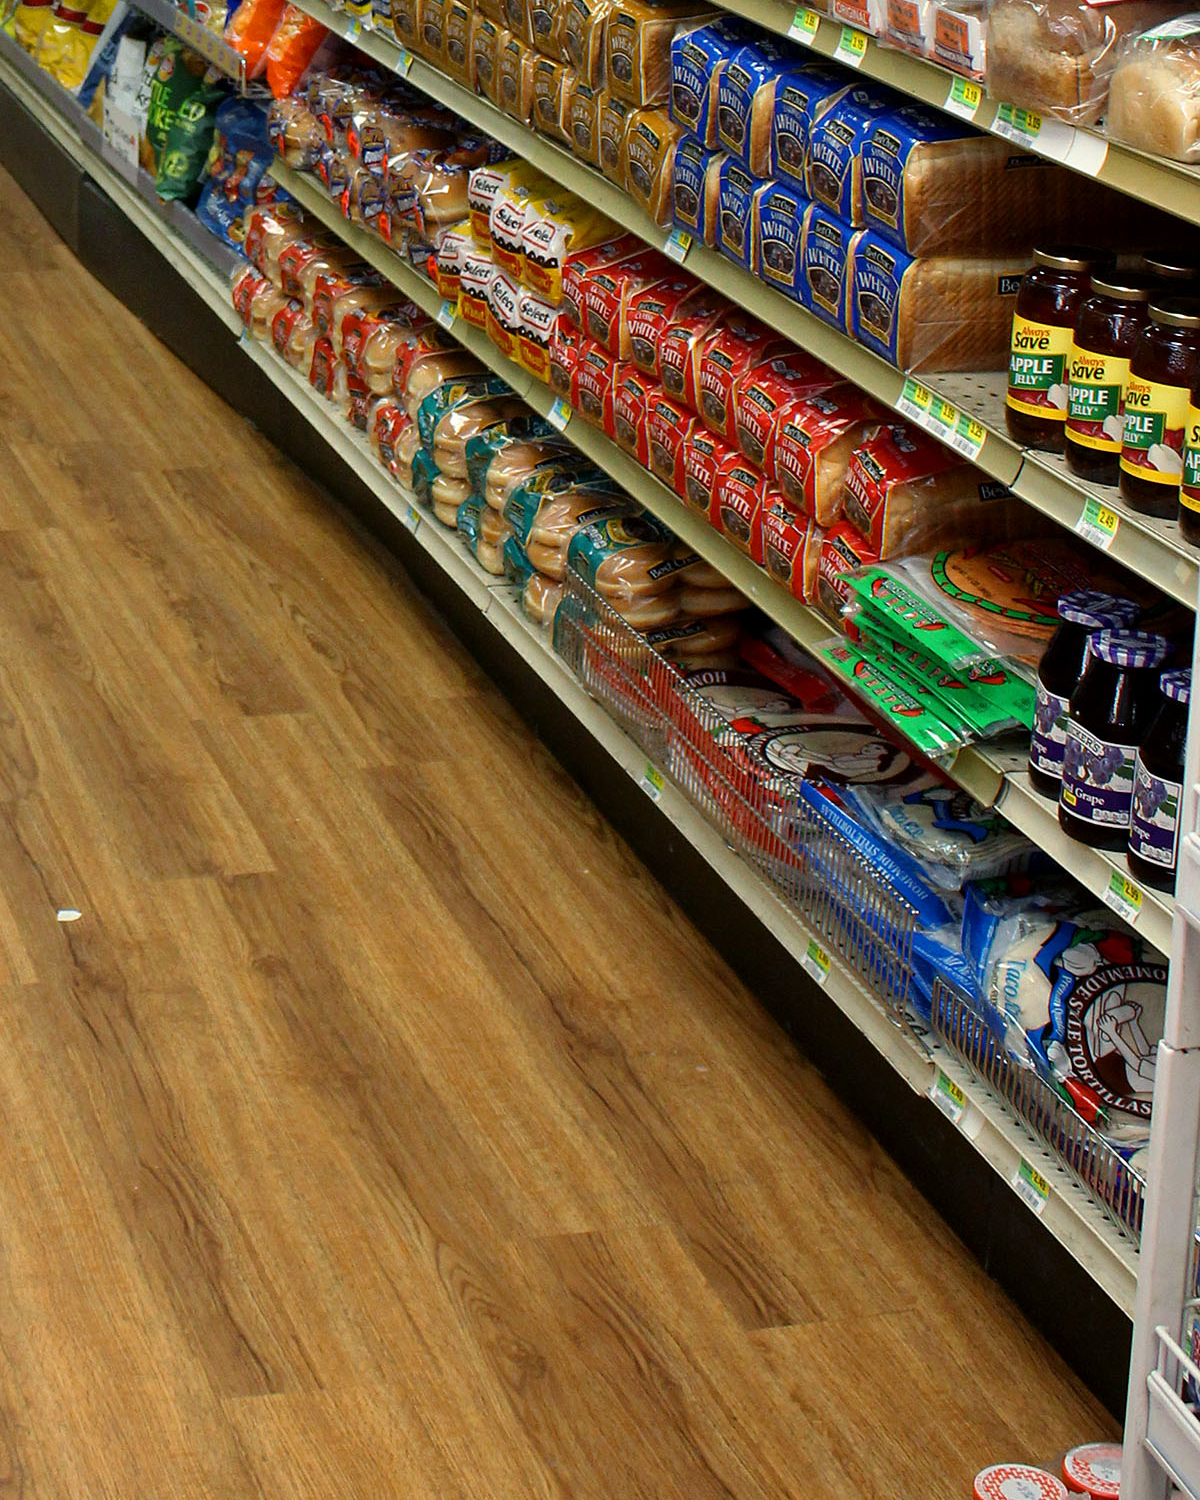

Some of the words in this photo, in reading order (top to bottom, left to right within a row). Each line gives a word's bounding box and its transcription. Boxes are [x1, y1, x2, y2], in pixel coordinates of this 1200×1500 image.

[674, 65, 703, 97] WHITE
[719, 87, 746, 117] WHITE
[776, 113, 805, 143] WHITE
[812, 142, 844, 176] WHITE
[675, 166, 700, 194] WHITE
[864, 157, 897, 190] WHITE
[473, 179, 499, 195] Select
[762, 220, 796, 248] WHITE
[463, 262, 490, 279] Select
[808, 248, 842, 277] WHITE
[1001, 278, 1019, 293] Be
[522, 303, 549, 324] Select
[628, 319, 657, 342] WHITE
[1022, 326, 1050, 338] Always
[1014, 332, 1050, 350] Save
[661, 348, 683, 368] HITE
[1010, 357, 1053, 375] APPLE
[1078, 356, 1106, 368] Always
[1014, 373, 1039, 385] JELLY
[1071, 362, 1105, 380] Save
[701, 371, 726, 400] WHITE
[1126, 388, 1150, 407] ave
[1071, 403, 1094, 416] JELLY
[1123, 414, 1154, 434] PPLE
[1123, 431, 1140, 444] ELLY
[720, 485, 751, 520] WHITE
[1099, 510, 1115, 529] 2.49
[820, 556, 849, 599] WHITE
[1074, 787, 1105, 807] Grape
[1076, 966, 1166, 1000] OMEMADE
[1067, 999, 1084, 1042] STYLE
[1069, 1044, 1151, 1115] TORTILLAS
